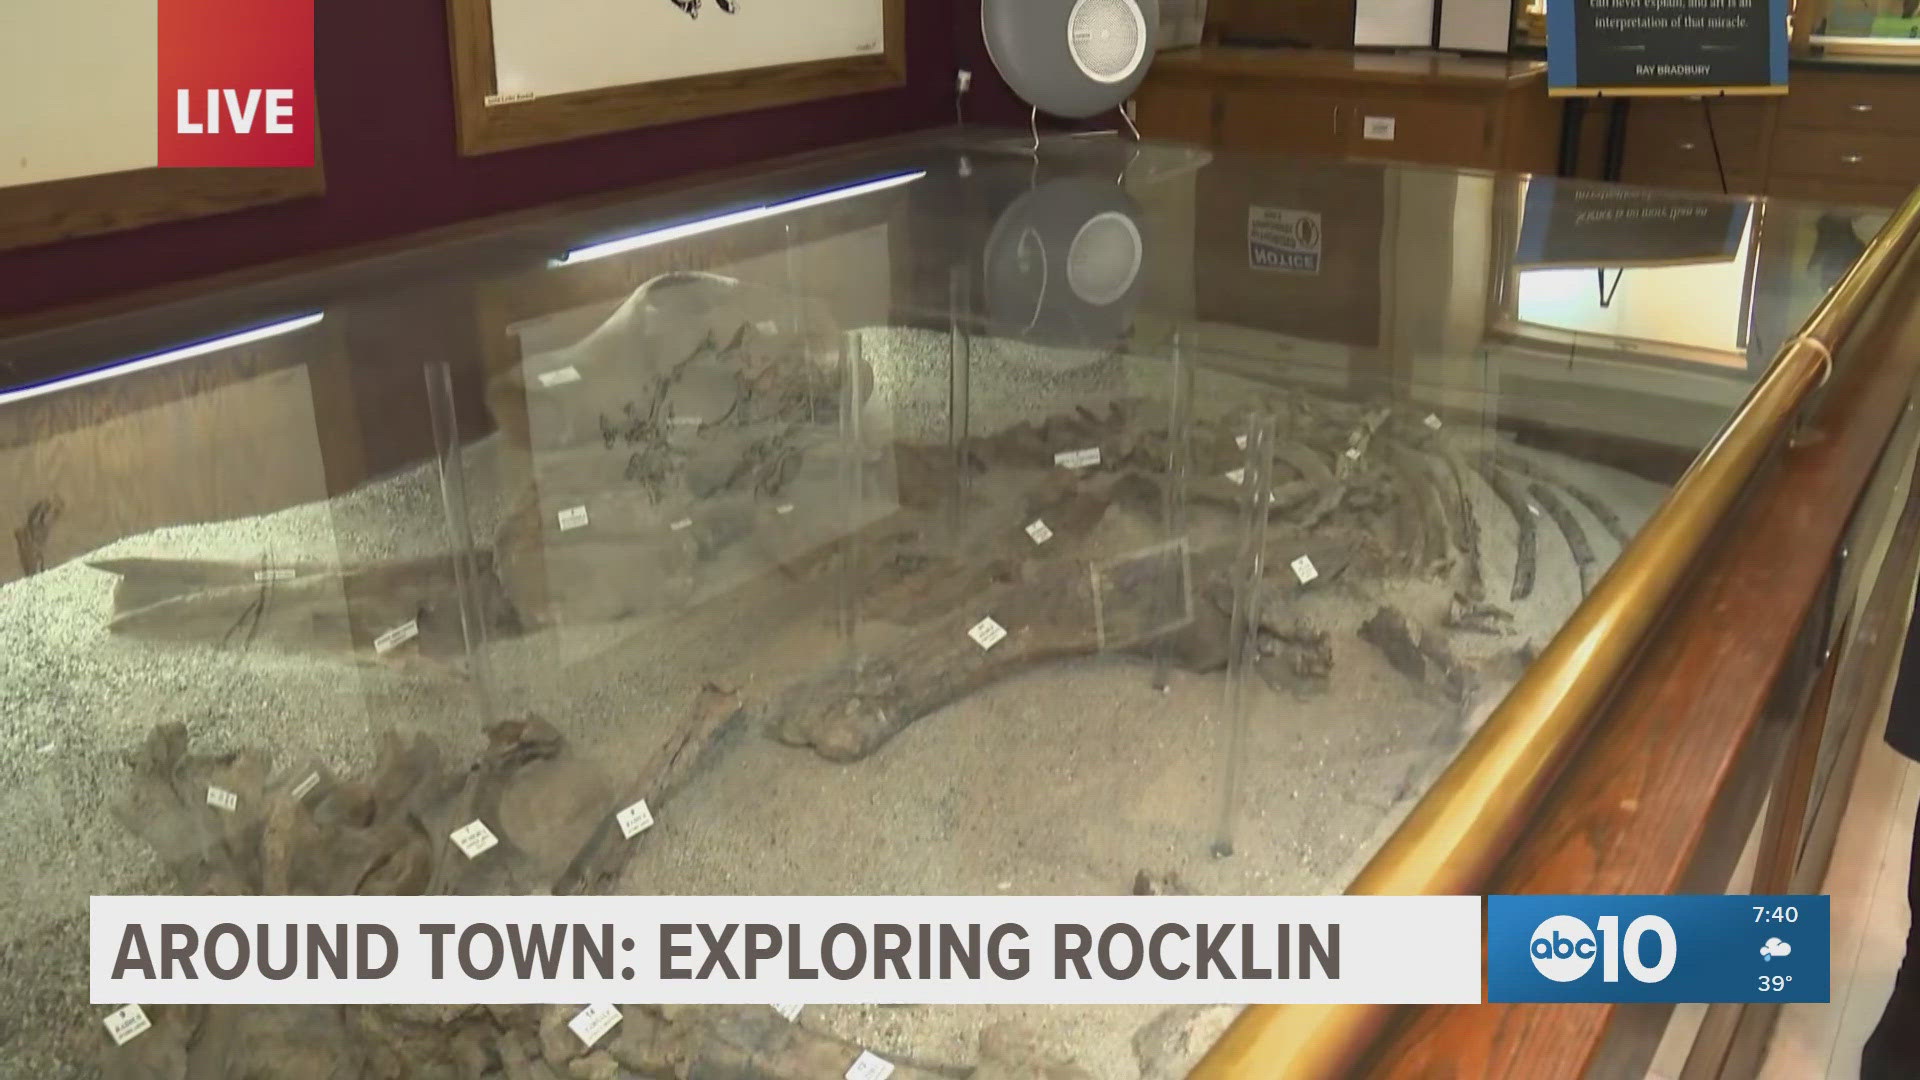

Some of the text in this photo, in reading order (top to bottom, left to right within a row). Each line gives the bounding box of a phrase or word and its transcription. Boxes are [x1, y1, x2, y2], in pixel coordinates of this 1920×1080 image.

[1612, 0, 1640, 8] never
[1688, 0, 1707, 8] and
[1711, 0, 1725, 9] art
[1739, 0, 1752, 8] an
[1595, 14, 1749, 32] interpretation of that miracle.
[1636, 65, 1711, 76] RAY BRADBURY
